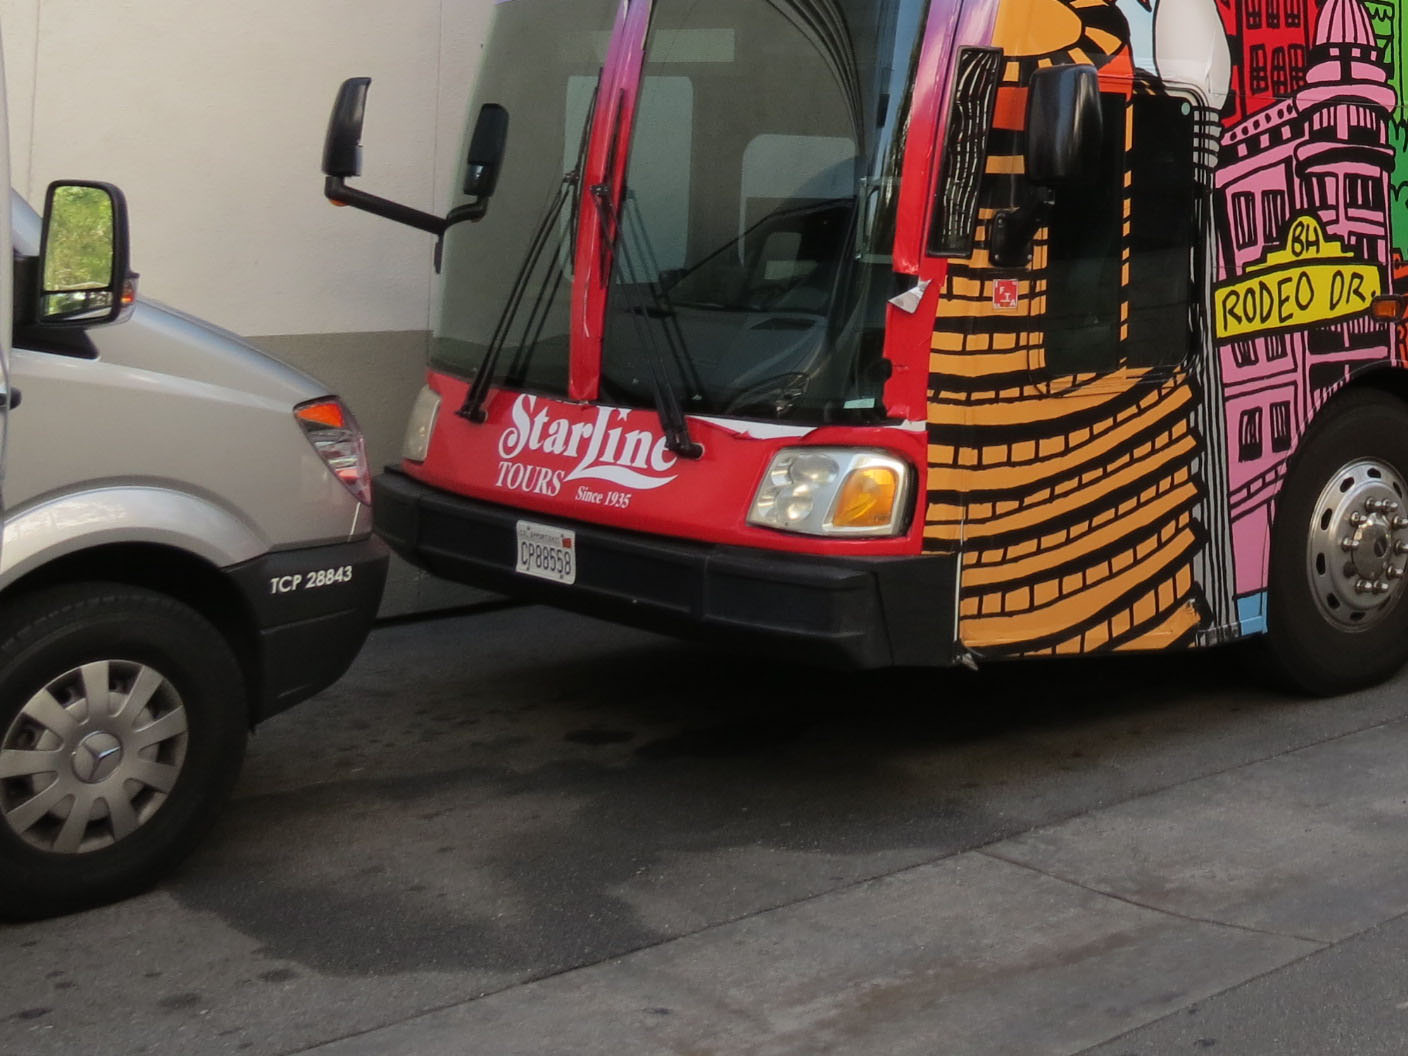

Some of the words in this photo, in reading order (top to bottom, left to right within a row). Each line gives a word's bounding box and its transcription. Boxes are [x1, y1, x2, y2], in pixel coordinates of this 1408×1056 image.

[1291, 221, 1321, 257] BH
[1222, 271, 1314, 332] RODEO
[1330, 270, 1377, 311] DR.
[496, 461, 565, 497] TOURS
[575, 485, 603, 505] Since
[604, 491, 632, 509] 1935
[520, 541, 572, 576] CP88558
[270, 574, 302, 594] TCP
[305, 565, 353, 589] 28843
